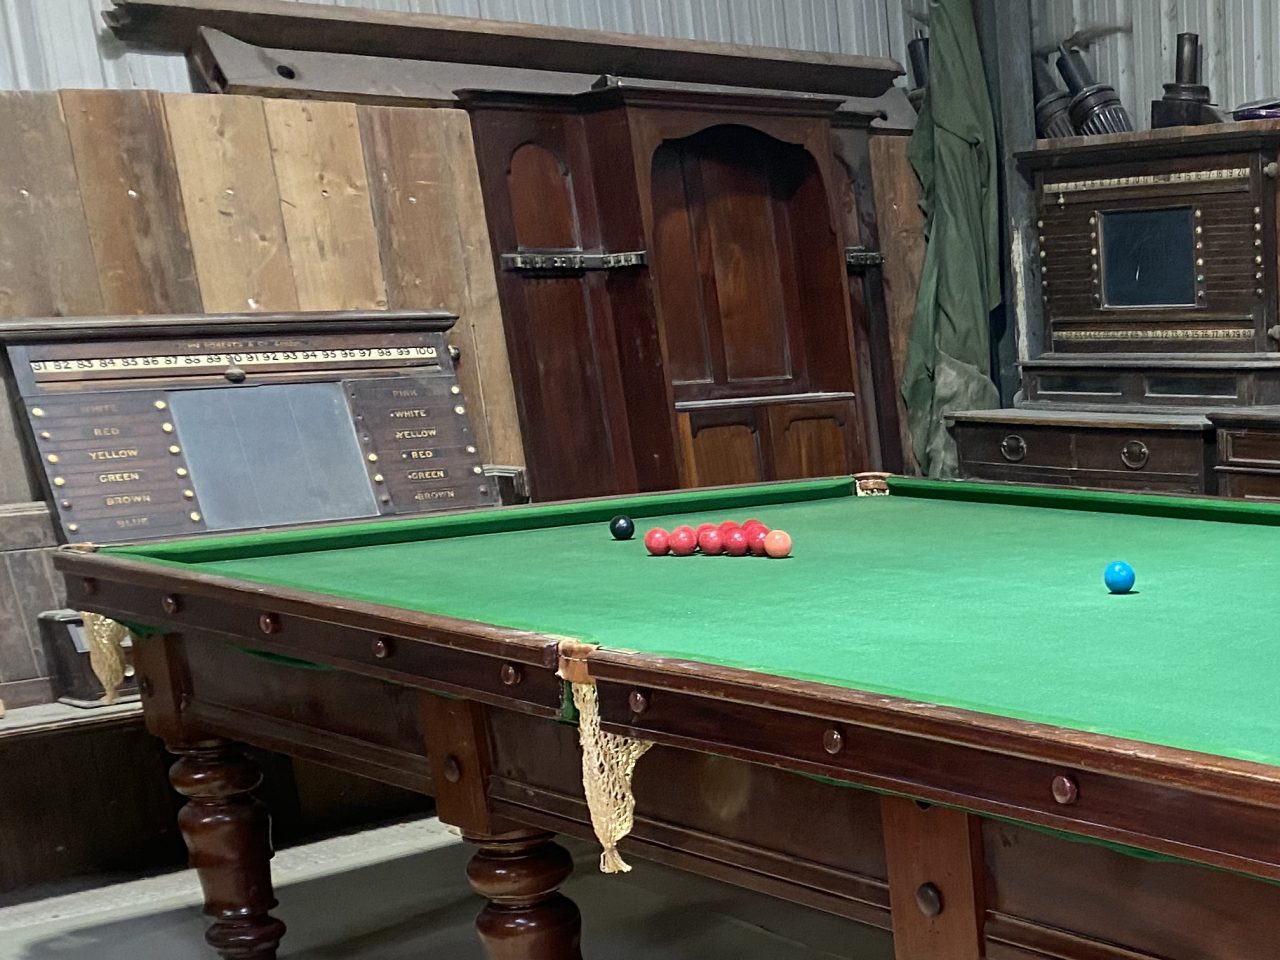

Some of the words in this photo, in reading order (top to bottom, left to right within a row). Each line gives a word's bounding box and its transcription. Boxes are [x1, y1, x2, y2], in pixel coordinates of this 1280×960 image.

[165, 356, 178, 365] 87
[185, 355, 201, 364] 88
[207, 355, 221, 363] 89
[246, 353, 258, 362] 91
[263, 352, 279, 361] 92
[283, 352, 298, 360] 93
[302, 351, 317, 359] 94
[322, 350, 337, 359] 95
[341, 349, 355, 358] 96
[359, 349, 372, 357] 97
[377, 348, 391, 356] 98
[397, 347, 410, 356] 99
[416, 347, 434, 355] 100
[396, 429, 436, 438] YELLOW
[89, 450, 138, 460] YELLOW
[99, 473, 139, 482] GREEN
[411, 471, 444, 479] GREEN
[417, 490, 454, 499] BROWN
[106, 495, 150, 505] BROWN
